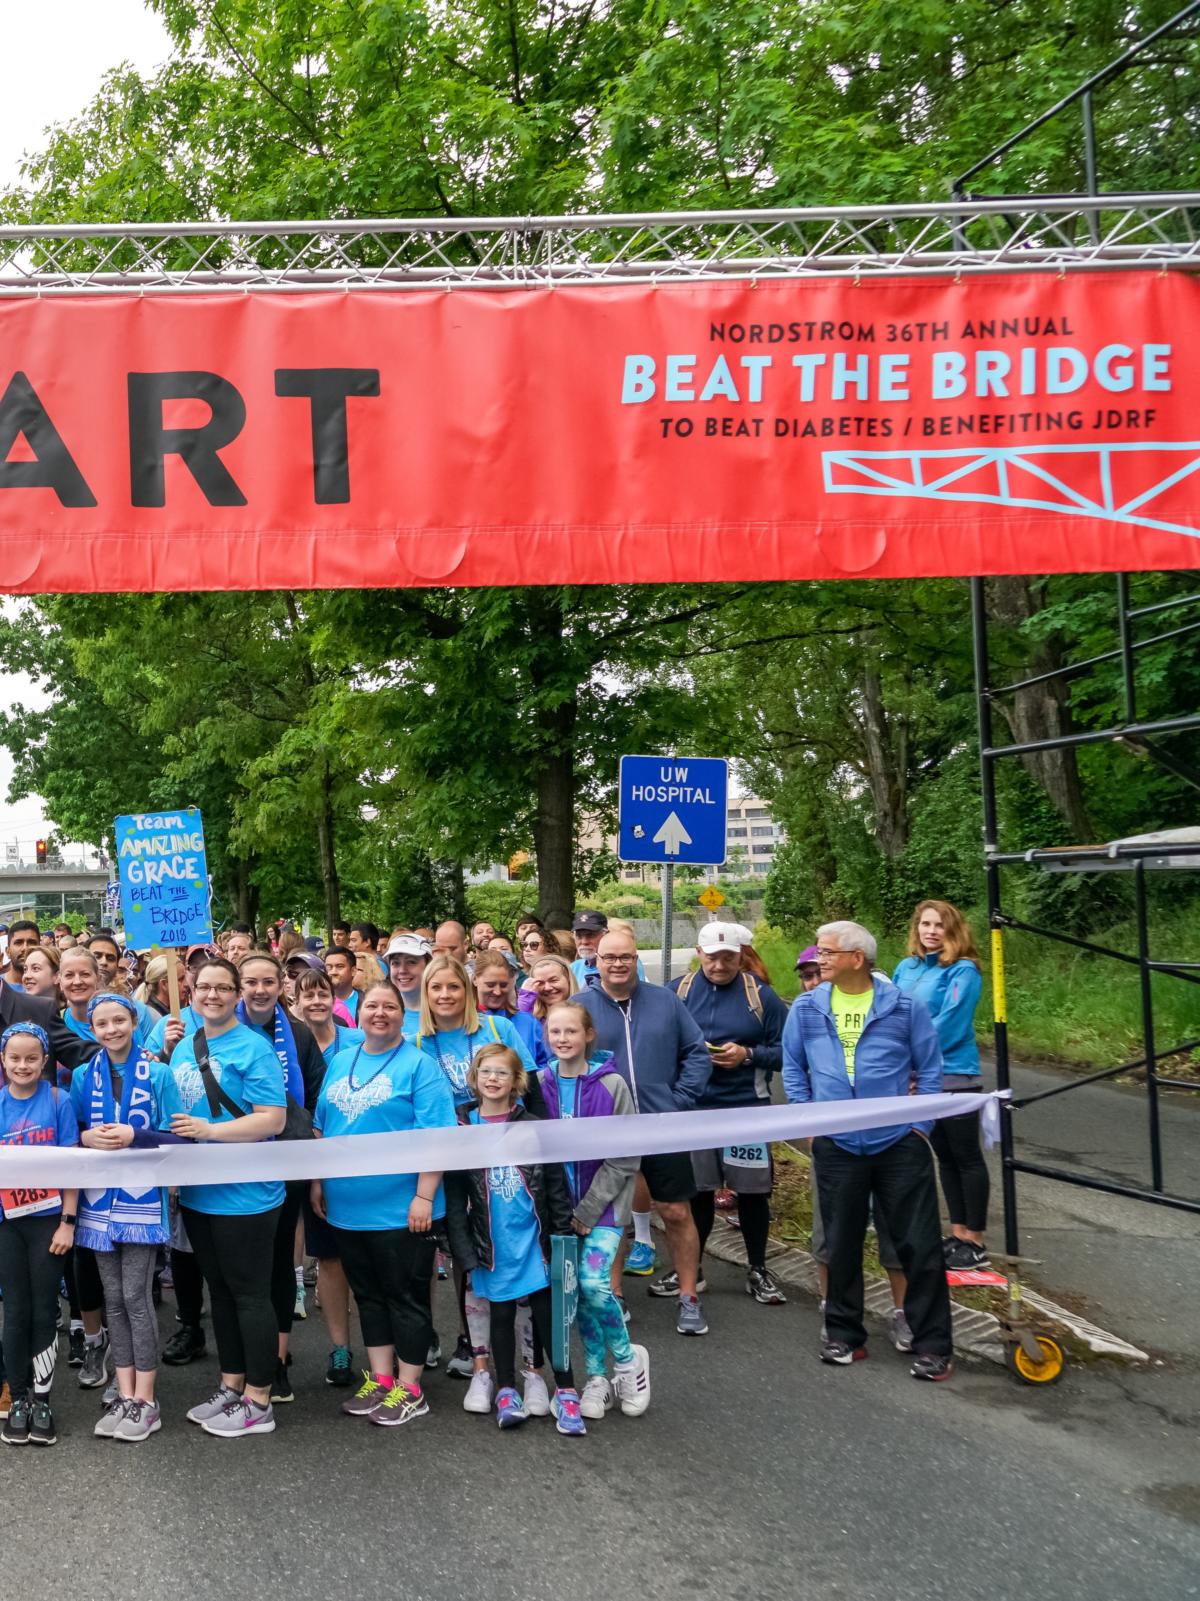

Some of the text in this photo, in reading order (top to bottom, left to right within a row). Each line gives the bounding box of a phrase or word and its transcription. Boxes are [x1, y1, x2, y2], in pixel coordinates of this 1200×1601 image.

[709, 316, 1074, 344] NORDSTROM 36TH ANNUAL
[621, 343, 1172, 404] BEAT THE BRIDGE
[660, 409, 1157, 439] TO BEAT DIABETES / BENEFITING JDRF
[660, 766, 689, 783] UW
[631, 784, 716, 805] HOSPITAL
[132, 815, 186, 831] Team
[120, 832, 205, 858] AMAZING
[127, 855, 201, 885] GRACE
[130, 885, 188, 901] BEAT THE
[150, 902, 204, 925] BRIDGE
[161, 928, 187, 942] 2018
[845, 1013, 866, 1029] PRI
[28, 1127, 54, 1145] THE
[730, 1145, 763, 1161] 9262
